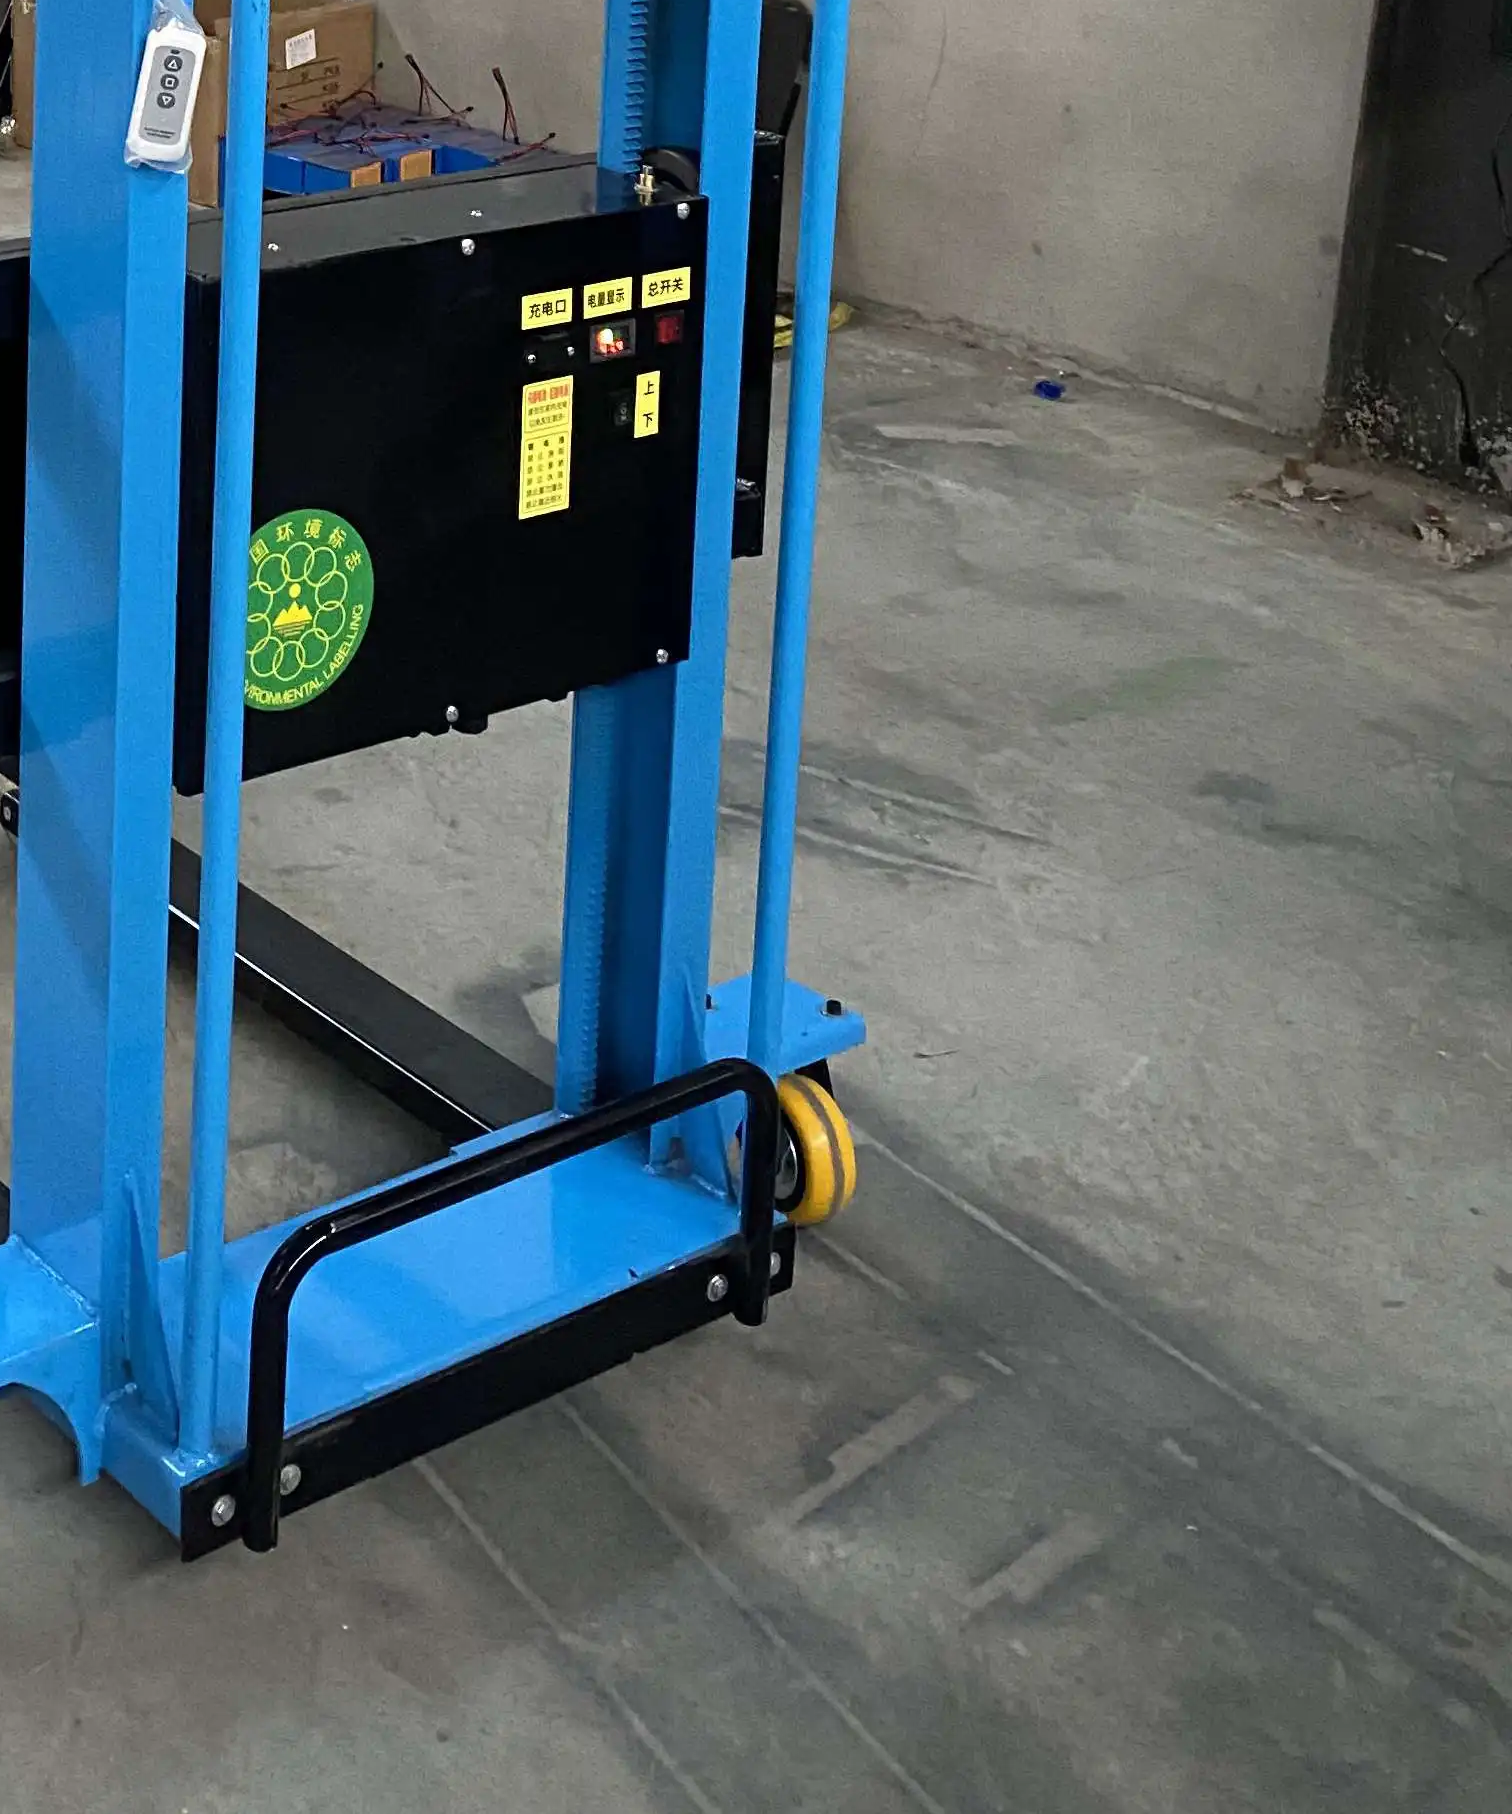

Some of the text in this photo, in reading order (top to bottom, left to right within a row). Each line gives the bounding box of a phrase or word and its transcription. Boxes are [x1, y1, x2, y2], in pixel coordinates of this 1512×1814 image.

[587, 287, 625, 308] 电量显示
[647, 277, 683, 297] 总开关
[528, 298, 567, 319] 充电口
[643, 380, 655, 396] 上
[642, 411, 654, 428] 下
[249, 518, 361, 572] 国环境标志
[322, 603, 364, 680] LABELLING
